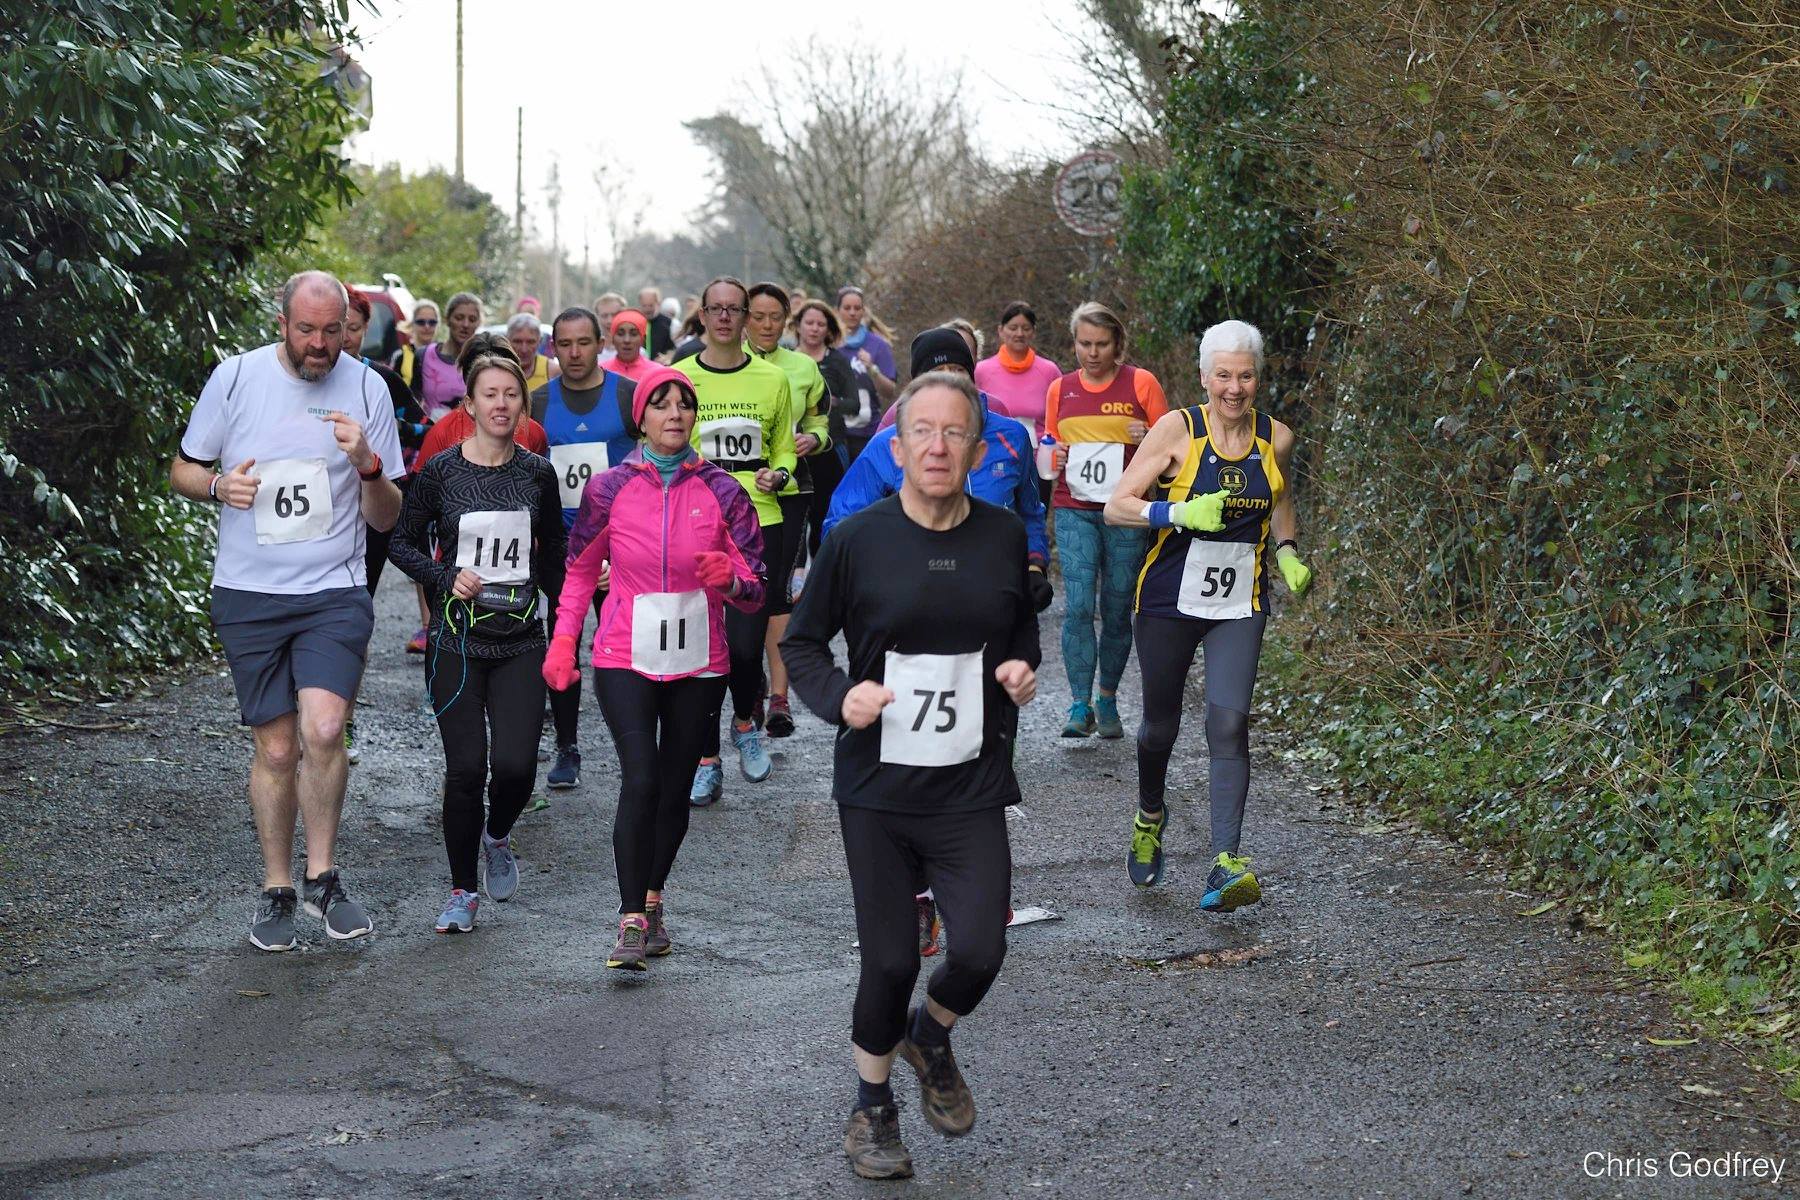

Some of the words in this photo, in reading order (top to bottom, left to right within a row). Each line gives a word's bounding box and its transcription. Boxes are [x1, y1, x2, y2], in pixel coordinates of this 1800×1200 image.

[696, 414, 714, 422] AD
[698, 402, 727, 411] OUTH
[730, 402, 758, 410] WEST
[1101, 402, 1134, 414] ORC
[714, 433, 752, 457] 100
[566, 463, 592, 489] 69
[1080, 460, 1107, 484] 40
[274, 484, 310, 518] 65
[474, 537, 520, 568] 114
[1200, 567, 1236, 598] 59
[660, 618, 686, 651] 11
[911, 689, 957, 733] 75
